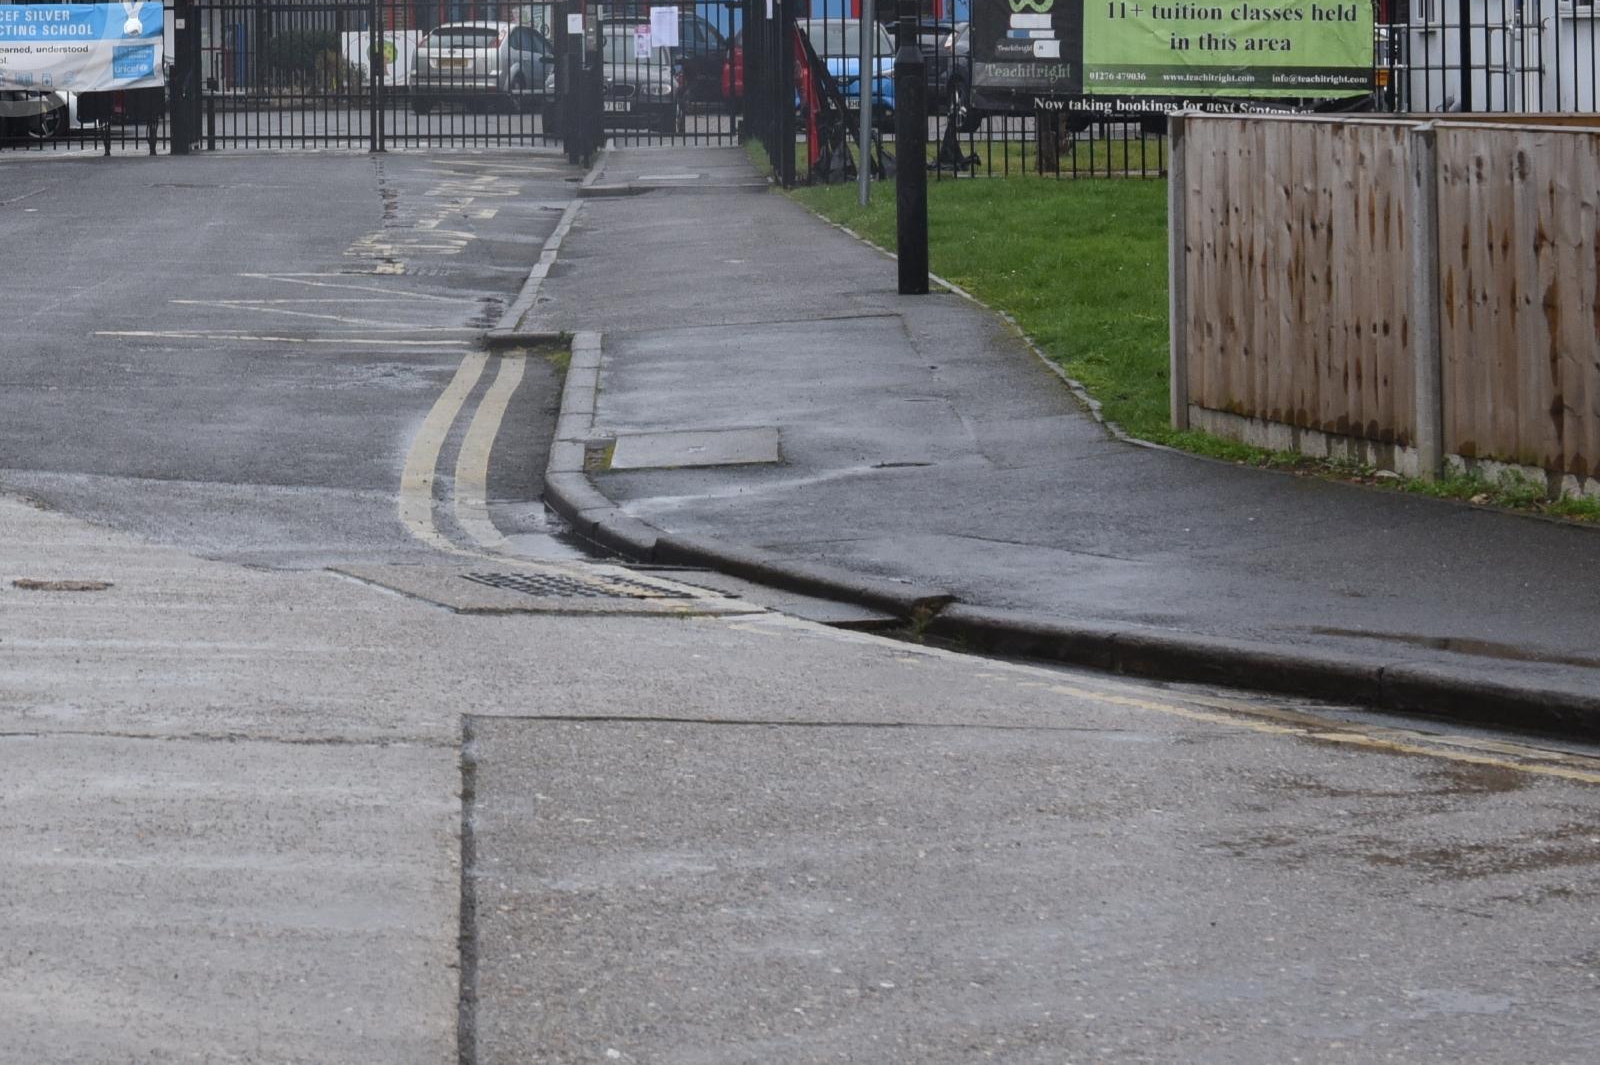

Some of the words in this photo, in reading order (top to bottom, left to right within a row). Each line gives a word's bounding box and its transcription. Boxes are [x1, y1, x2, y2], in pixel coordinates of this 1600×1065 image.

[25, 10, 70, 22] SILVER
[1106, 1, 1144, 19] 11+
[1151, 2, 1223, 21] tuition
[1230, 3, 1303, 22] classes
[1311, 3, 1358, 22] held
[42, 24, 93, 36] SCHOOL
[1169, 32, 1190, 51] in
[1198, 33, 1237, 52] this
[1244, 37, 1292, 51] area
[36, 44, 89, 53] understood
[1089, 72, 1114, 81] 01276
[1163, 72, 1255, 84] www.teachitright.com
[1272, 72, 1368, 84] info@teachitright.com
[1034, 97, 1065, 111] Now
[1068, 99, 1113, 114] taking
[1117, 99, 1178, 115] bookings
[1183, 99, 1203, 111] for
[1206, 101, 1236, 114] next
